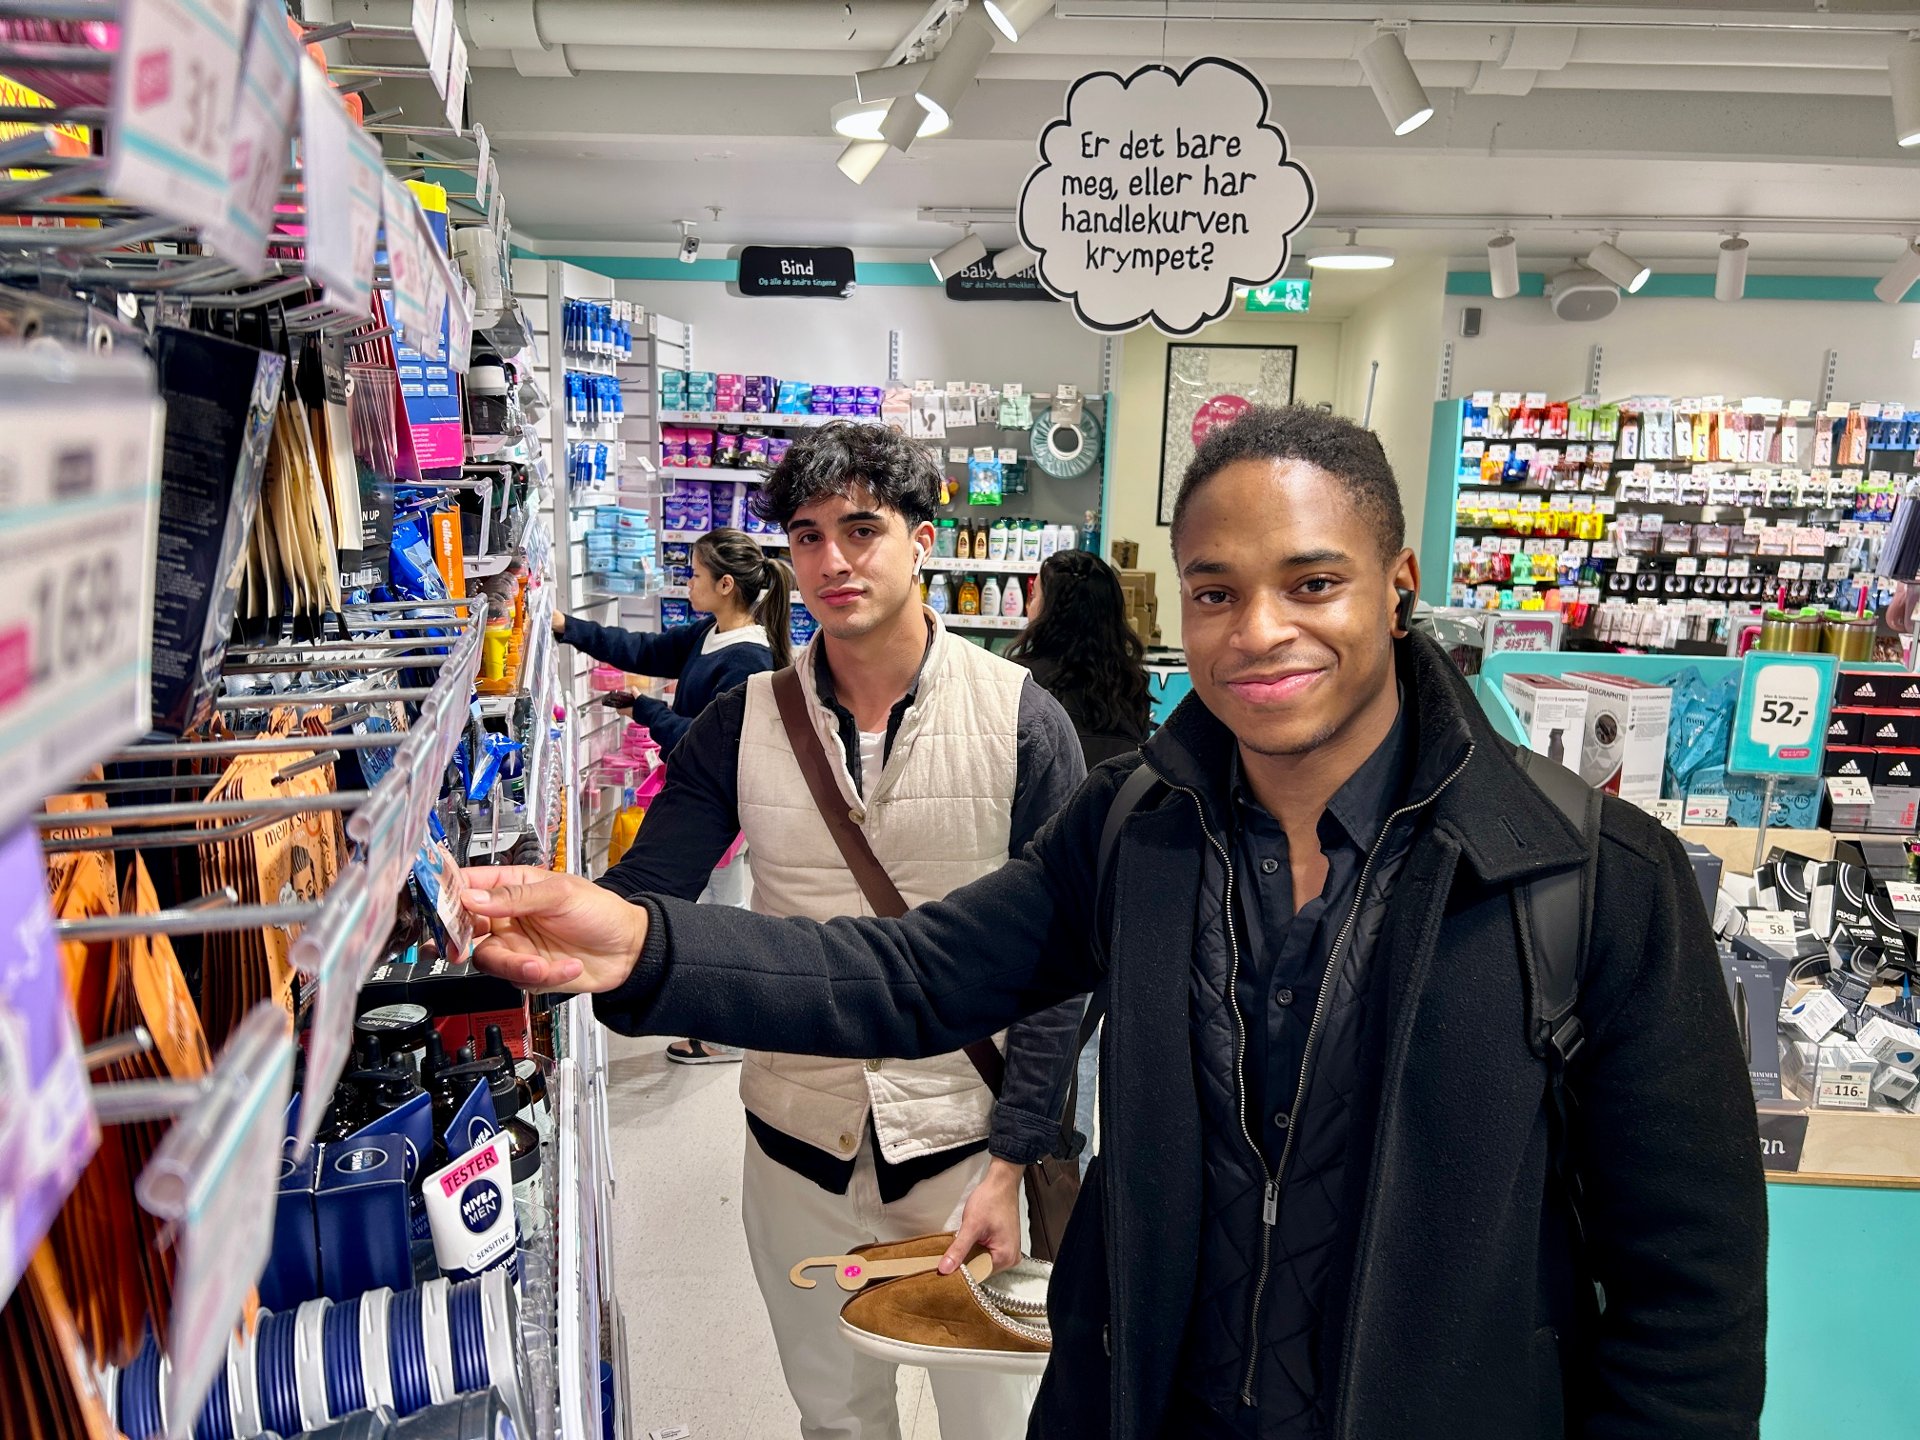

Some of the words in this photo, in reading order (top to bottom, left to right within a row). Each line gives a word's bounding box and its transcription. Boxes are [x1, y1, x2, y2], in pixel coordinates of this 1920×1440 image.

[1081, 131, 1110, 158] Er
[1120, 129, 1164, 160] det
[1176, 127, 1242, 159] bare
[1062, 174, 1118, 200] meg,
[1129, 166, 1192, 196] eller
[1203, 164, 1257, 196] har
[1061, 202, 1249, 234] handlekurven
[780, 259, 814, 275] Bind
[1086, 239, 1214, 276] krympet?
[758, 277, 769, 286] Og
[770, 277, 781, 286] alle
[783, 278, 791, 286] de
[792, 278, 811, 286] andre
[369, 510, 380, 521] UP
[441, 519, 453, 557] Gillette
[1504, 637, 1535, 649] SISTE
[1854, 690, 1876, 698] adidas
[1760, 700, 1808, 727] 52,-
[1904, 802, 1916, 826] Force
[264, 821, 288, 848] men
[1836, 909, 1858, 922] AXE
[1849, 928, 1876, 936] AXE
[1882, 935, 1904, 947] AXE
[444, 1151, 495, 1192] TESTER
[462, 1188, 498, 1216] NIVEA
[468, 1200, 497, 1226] MEN
[476, 1232, 510, 1261] SENSITIVE
